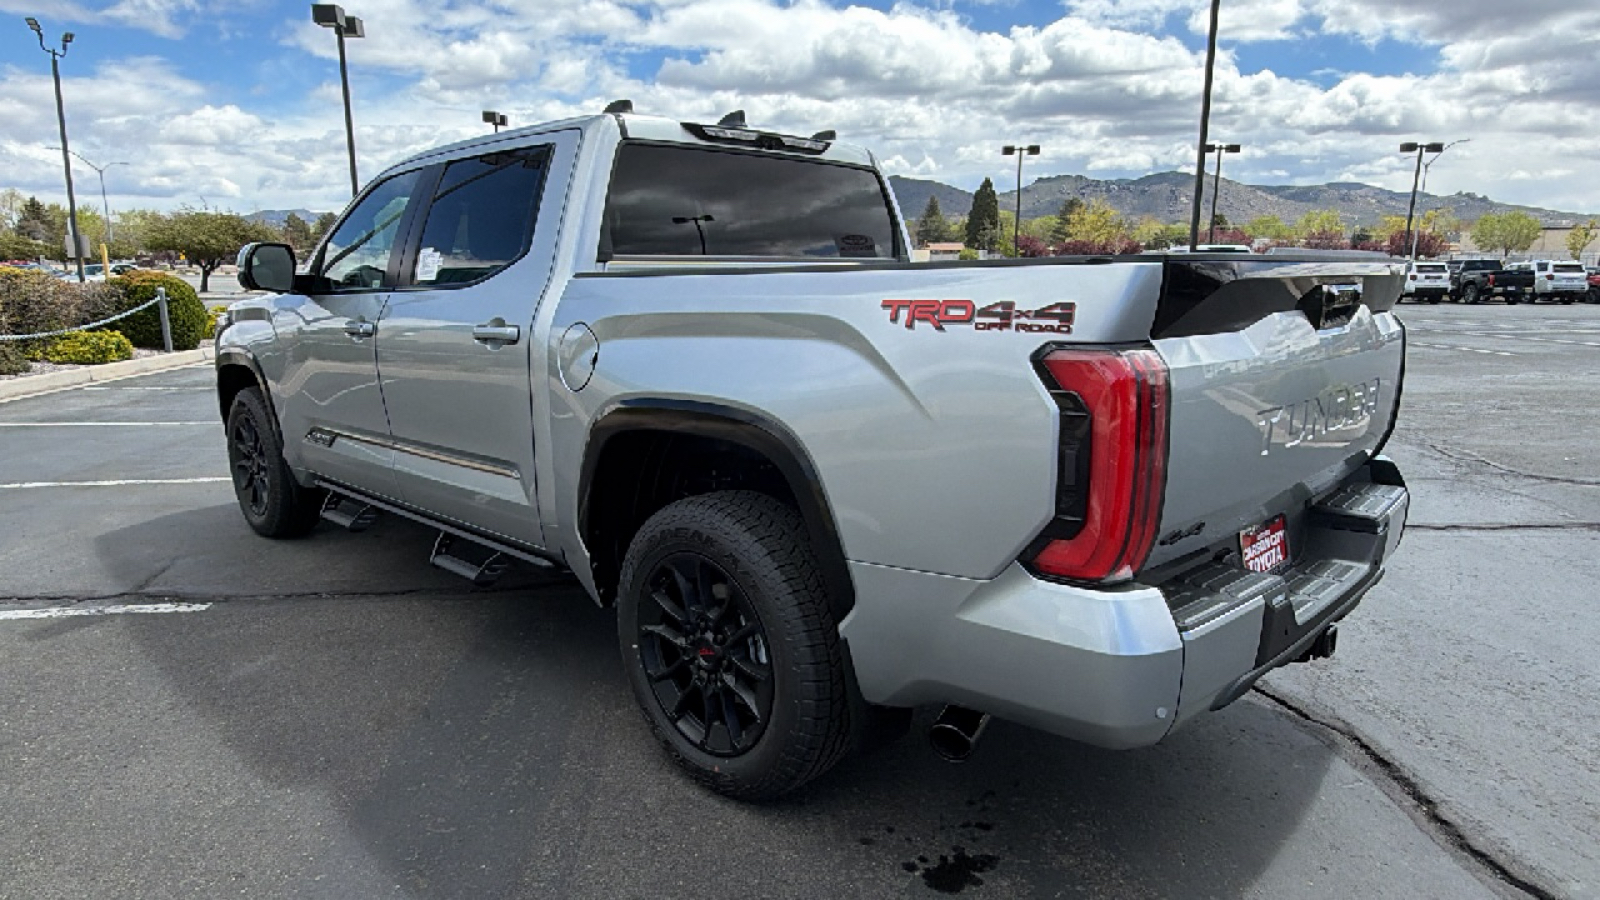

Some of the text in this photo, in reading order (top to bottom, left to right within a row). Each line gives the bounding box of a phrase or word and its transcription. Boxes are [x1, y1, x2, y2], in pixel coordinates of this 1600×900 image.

[881, 299, 1076, 332] TRD 4x4
[974, 321, 1072, 334] OFF ROAD
[1257, 377, 1381, 456] TUNDRA
[1244, 536, 1271, 561] CARSON
[1248, 544, 1284, 572] TOYOTA
